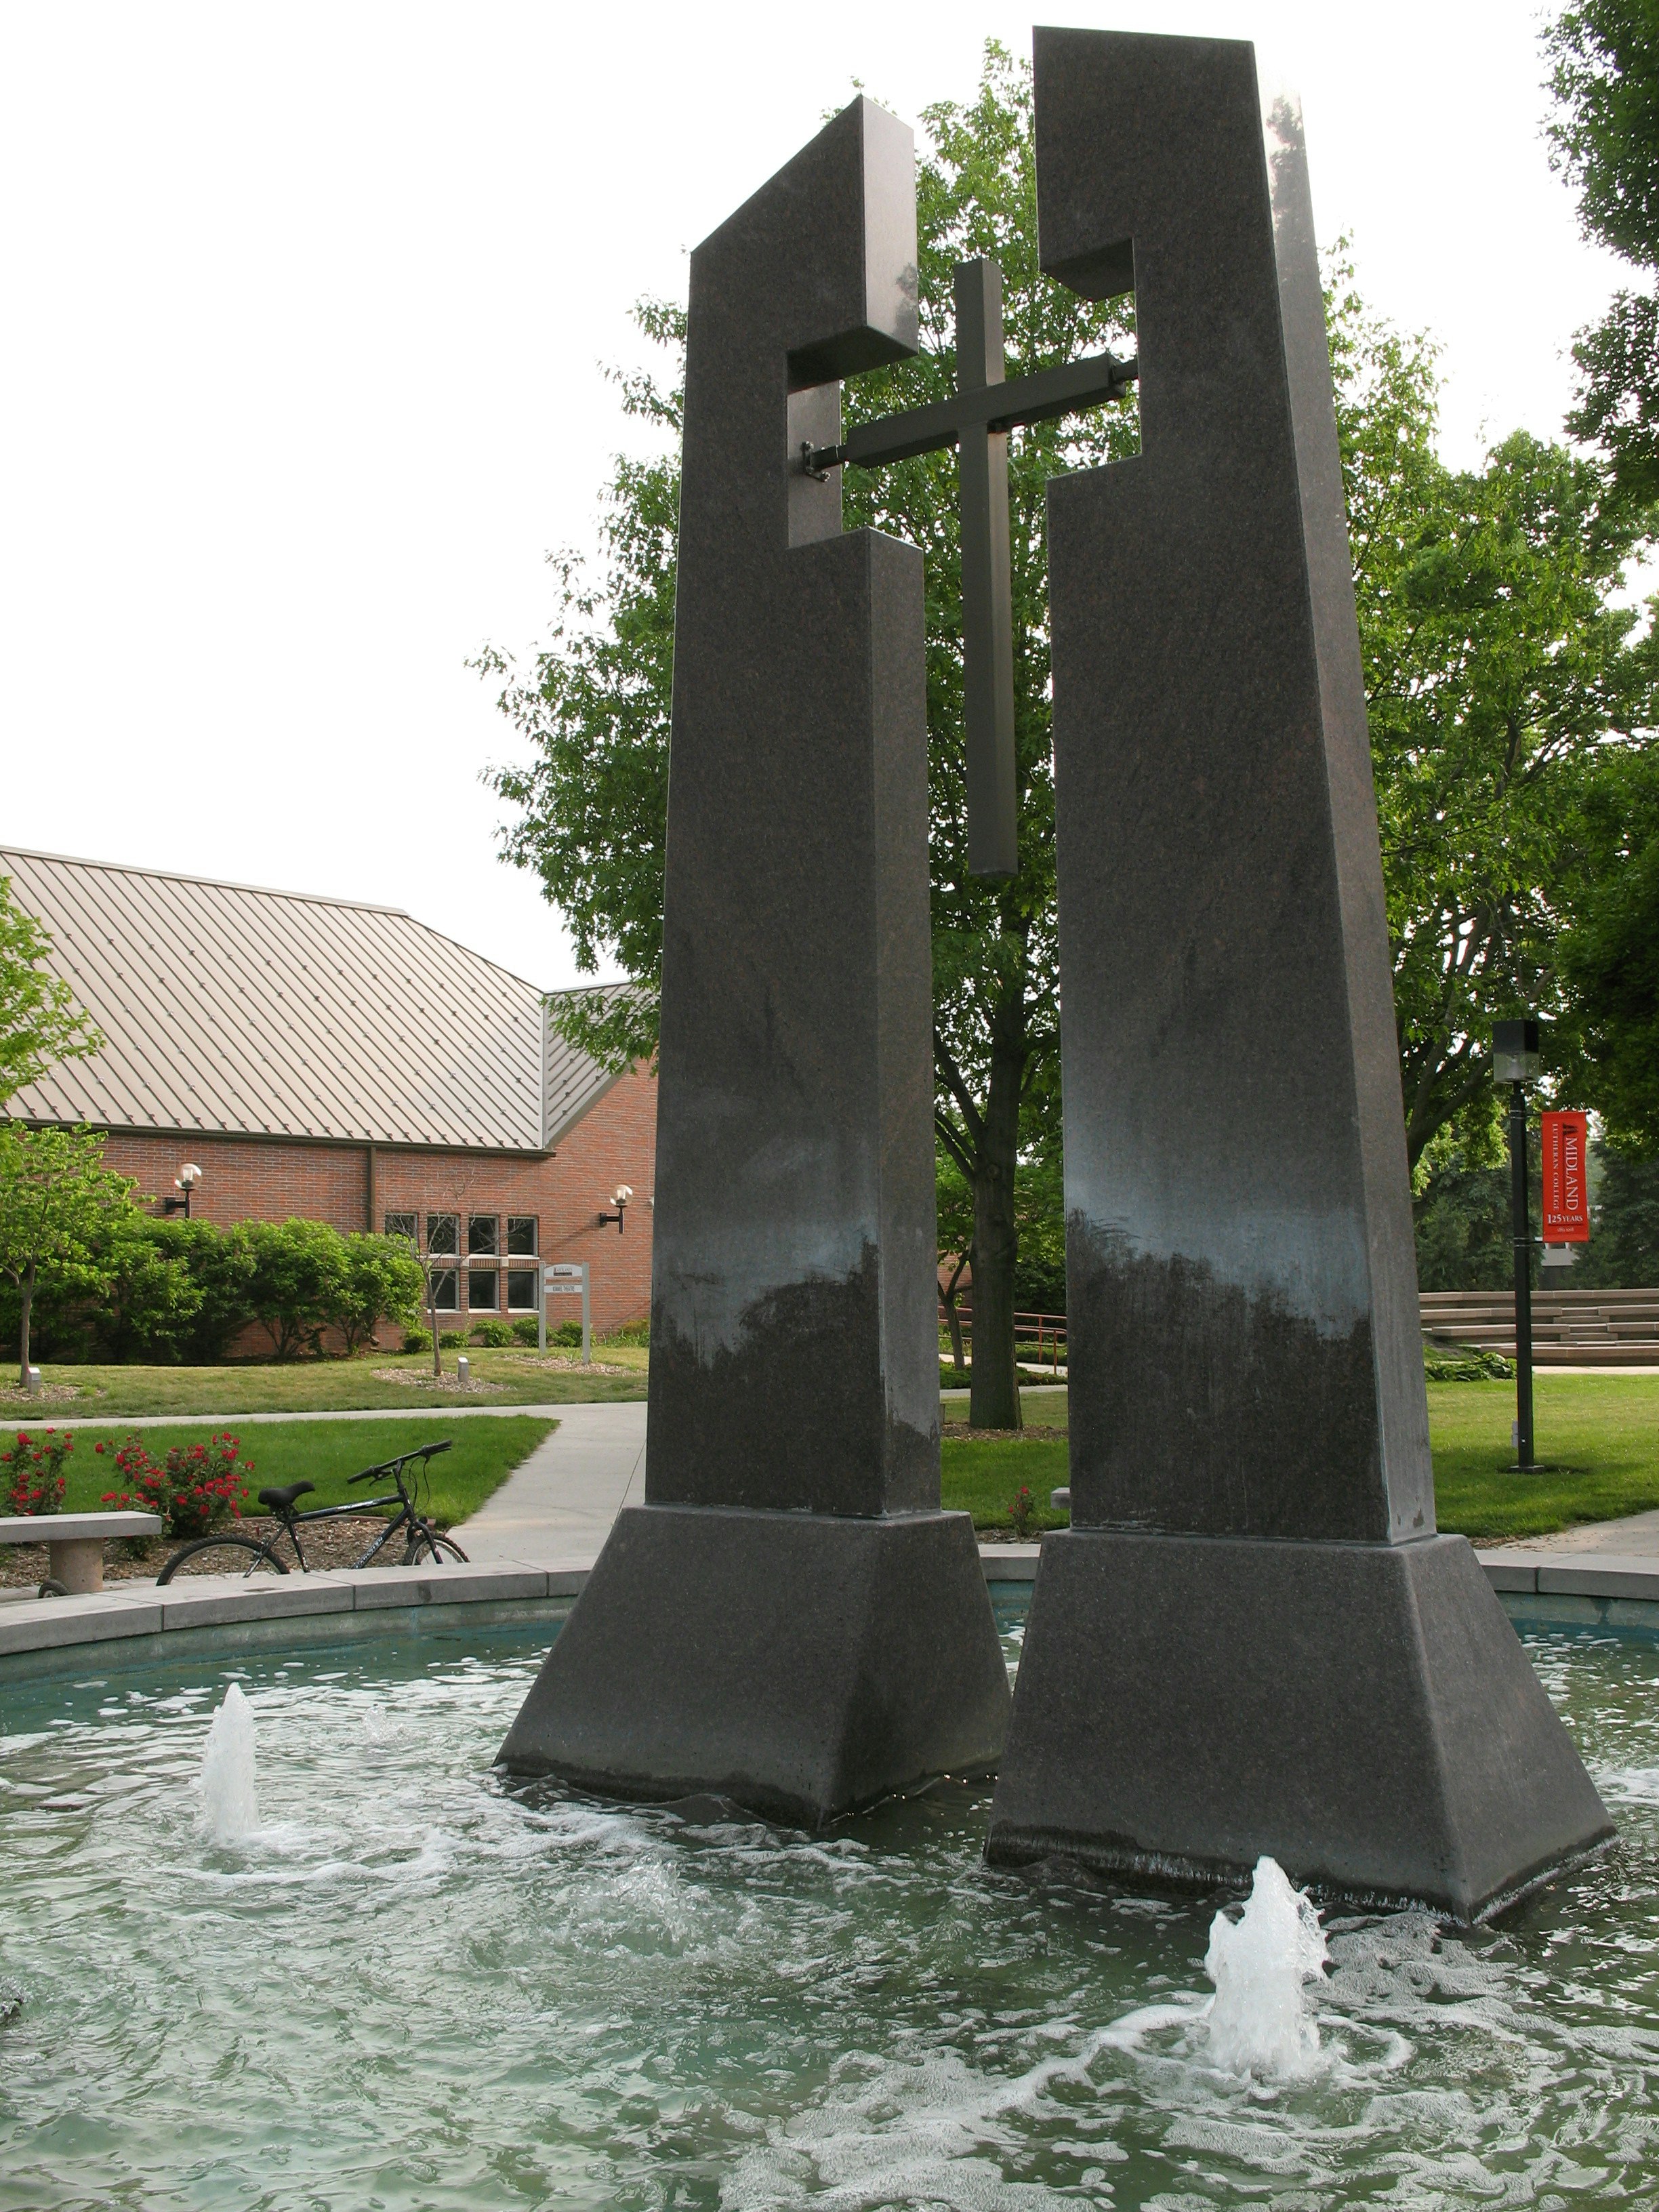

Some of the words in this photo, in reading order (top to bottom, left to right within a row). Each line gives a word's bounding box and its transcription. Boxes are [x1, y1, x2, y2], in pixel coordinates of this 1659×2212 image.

[1566, 1137, 1578, 1211] MIDLAND
[1547, 1213, 1561, 1224] 125
[1562, 1214, 1583, 1223] YEARS
